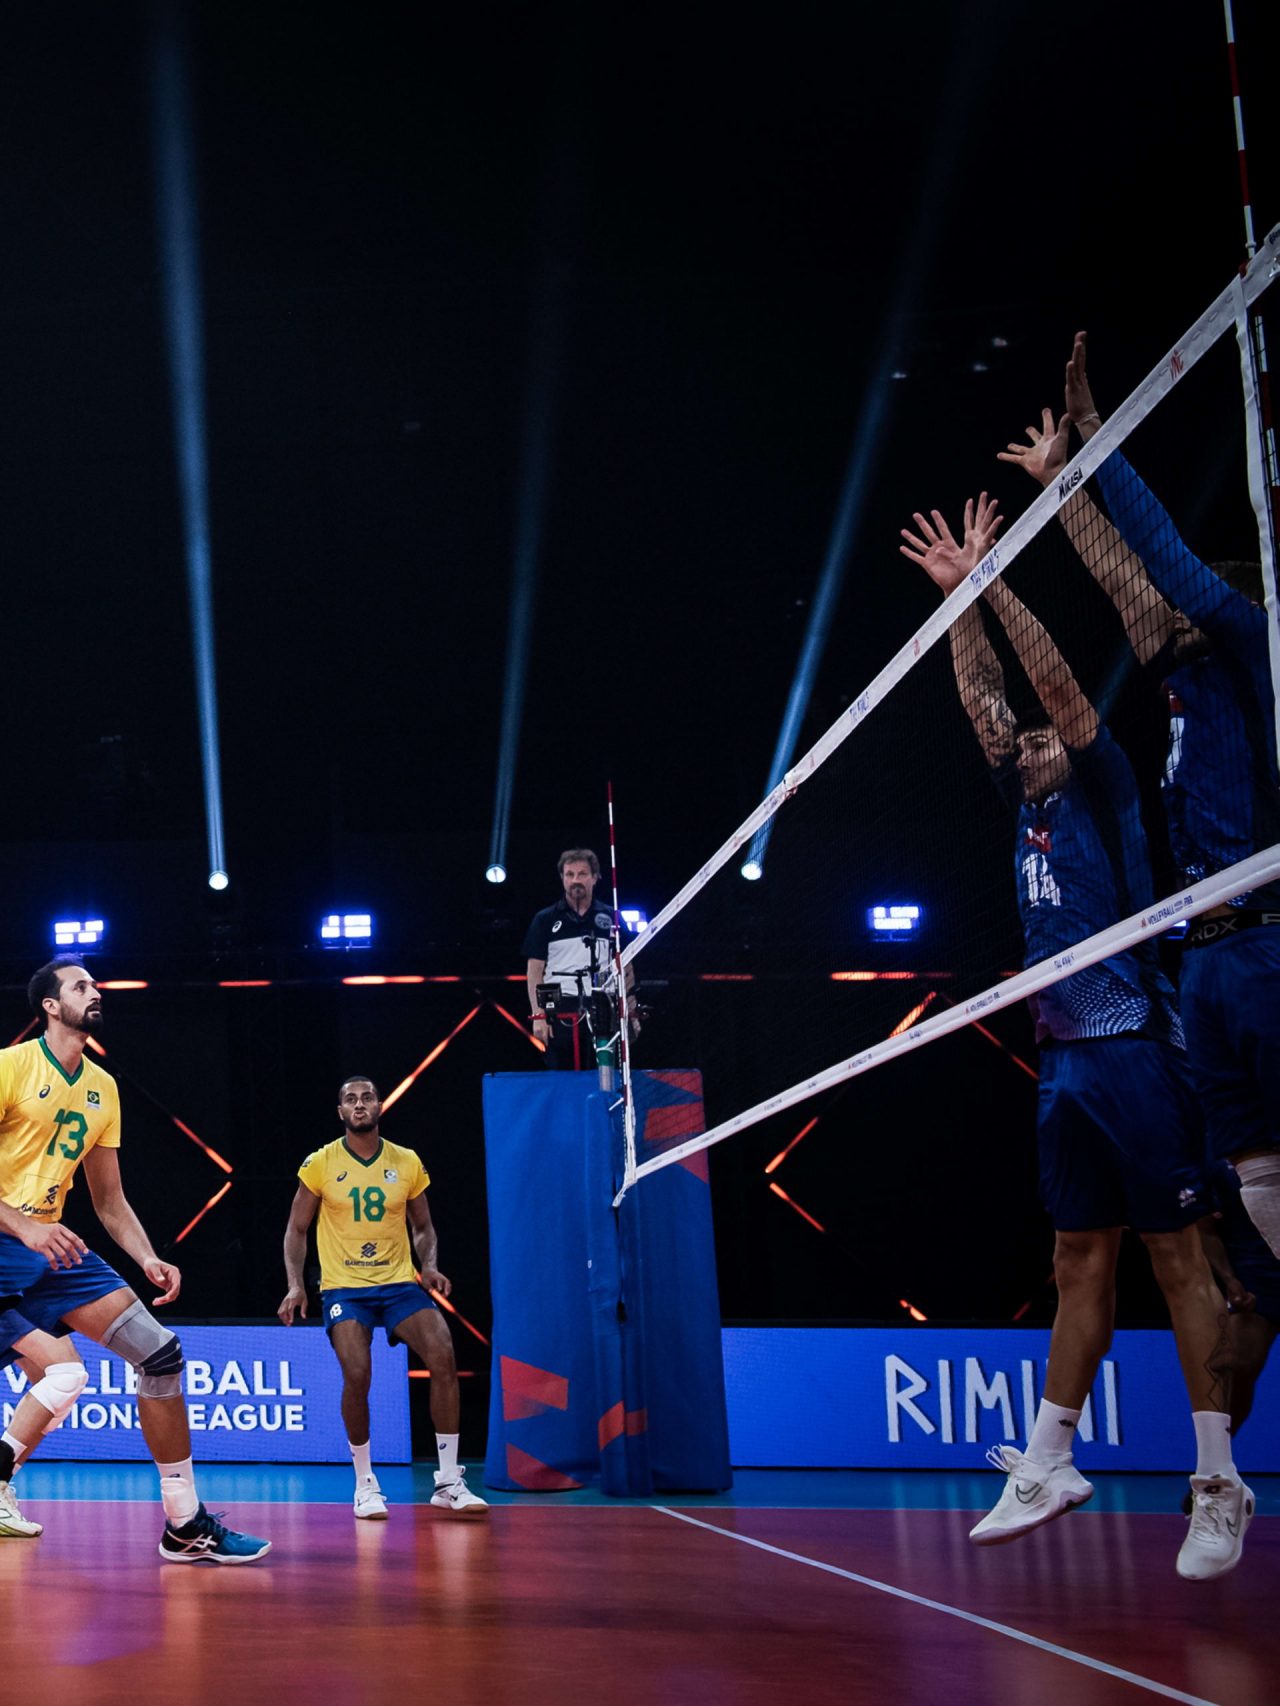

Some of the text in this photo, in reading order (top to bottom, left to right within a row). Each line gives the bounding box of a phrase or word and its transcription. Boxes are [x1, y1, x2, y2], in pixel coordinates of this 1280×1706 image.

[46, 1108, 89, 1161] 13
[348, 1187, 387, 1222] 18
[330, 1303, 344, 1319] 18
[884, 1354, 1120, 1446] RIMII
